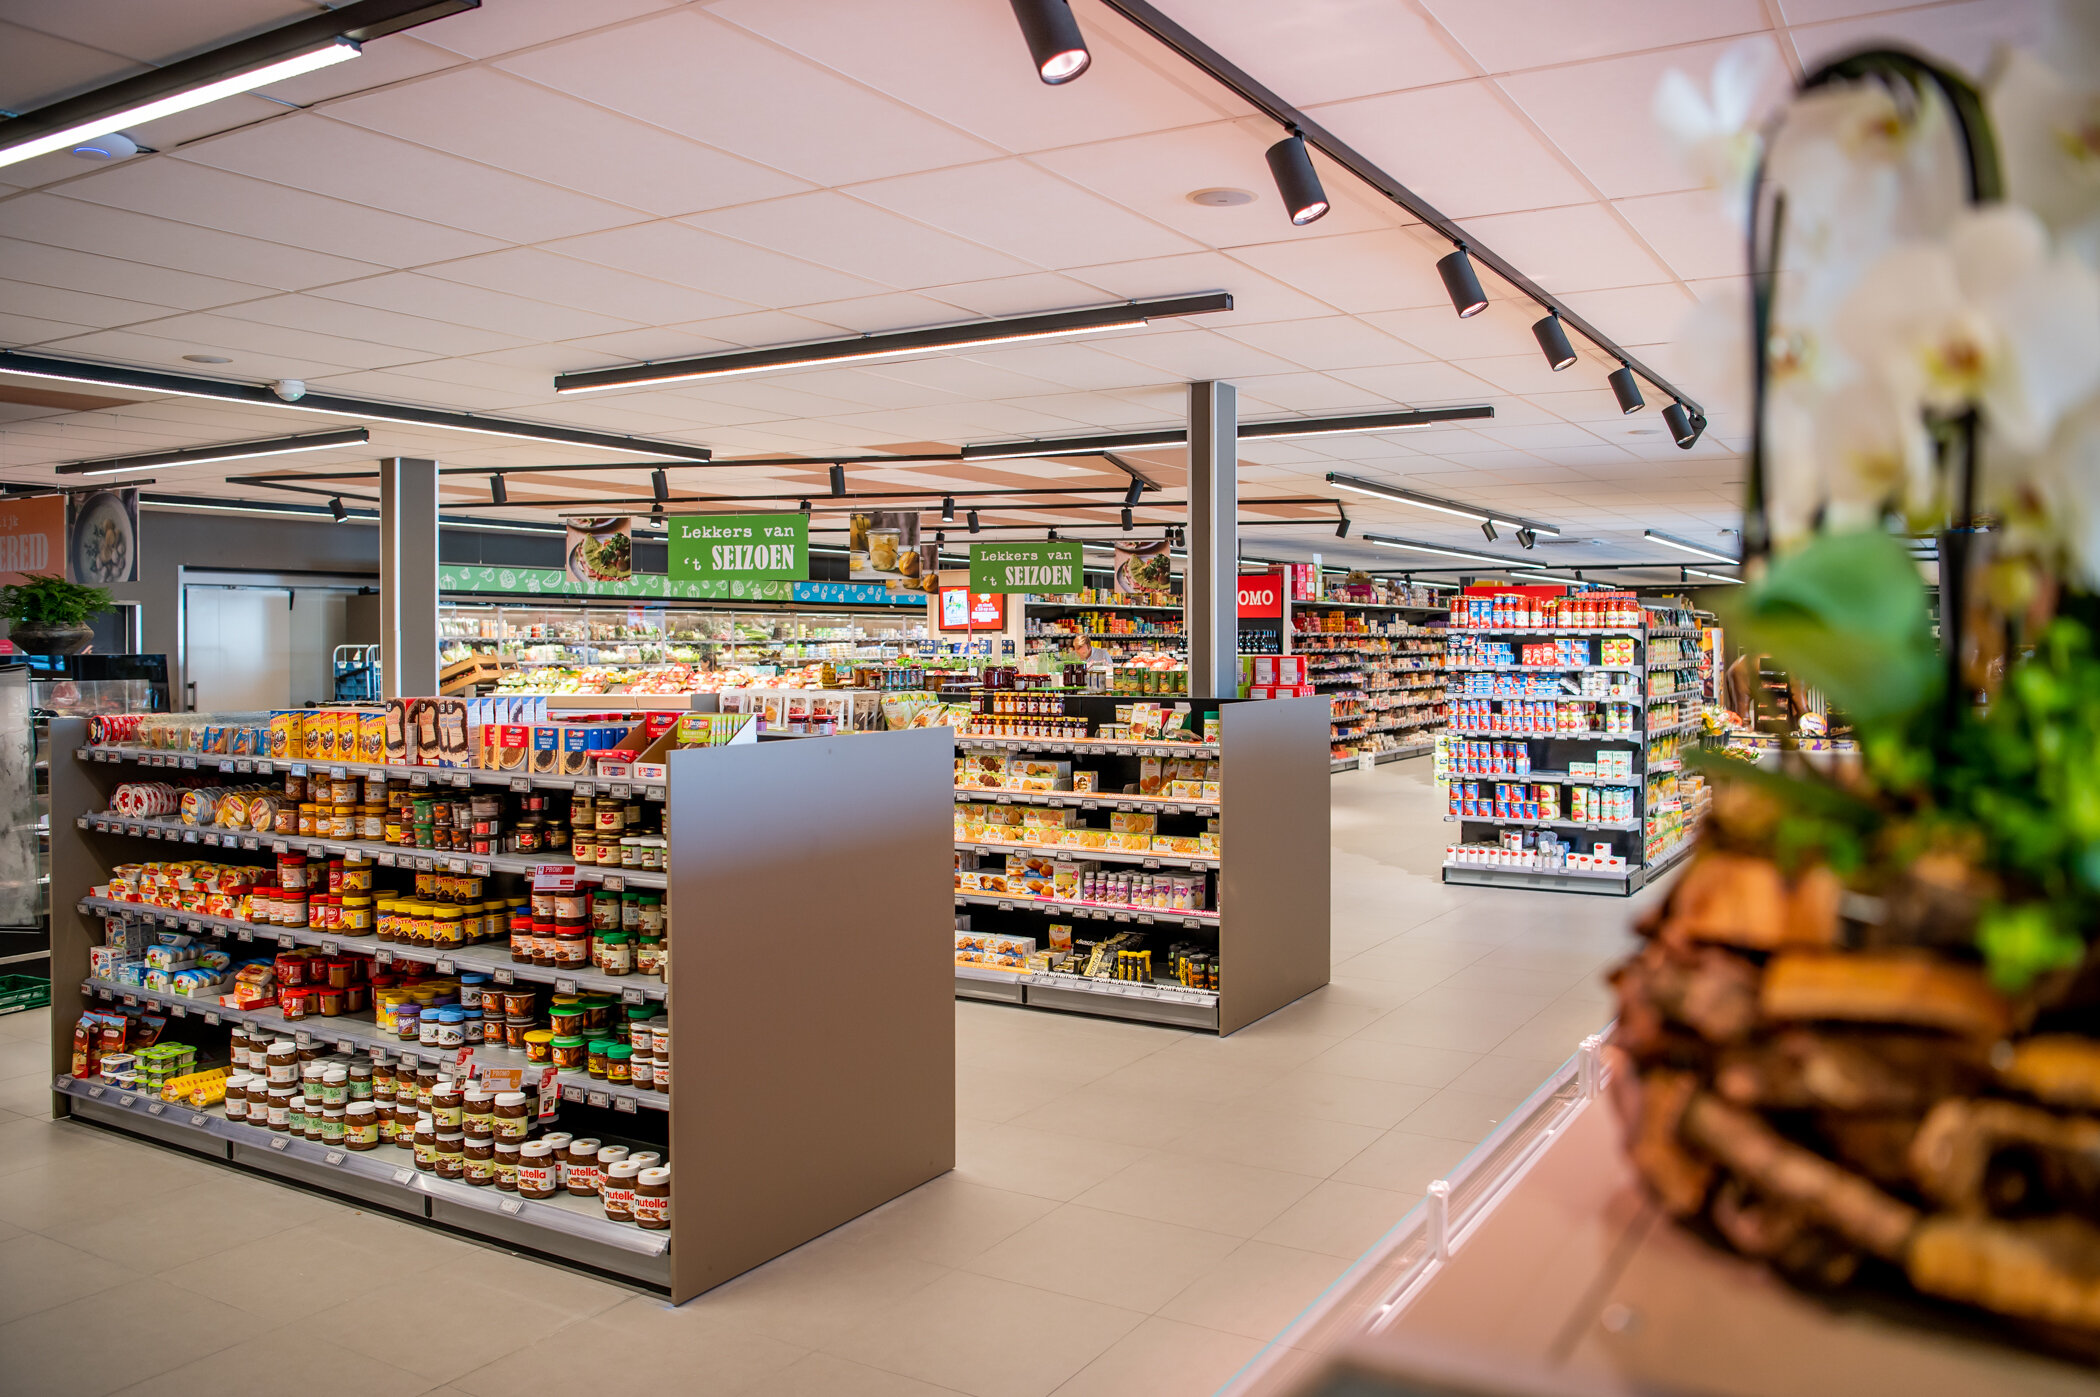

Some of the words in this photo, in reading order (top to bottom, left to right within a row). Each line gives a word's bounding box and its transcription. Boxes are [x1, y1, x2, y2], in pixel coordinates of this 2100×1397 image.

[682, 526, 752, 539] Lekkers
[764, 527, 795, 537] van
[712, 545, 795, 570] SEIZOEN
[981, 551, 1038, 561] Lekkers
[1048, 552, 1072, 560] van
[1005, 565, 1072, 585] SEIZOEN
[1238, 590, 1274, 606] OMO
[517, 1167, 547, 1179] nutella
[567, 1166, 599, 1177] nutella
[635, 1198, 668, 1208] nutella
